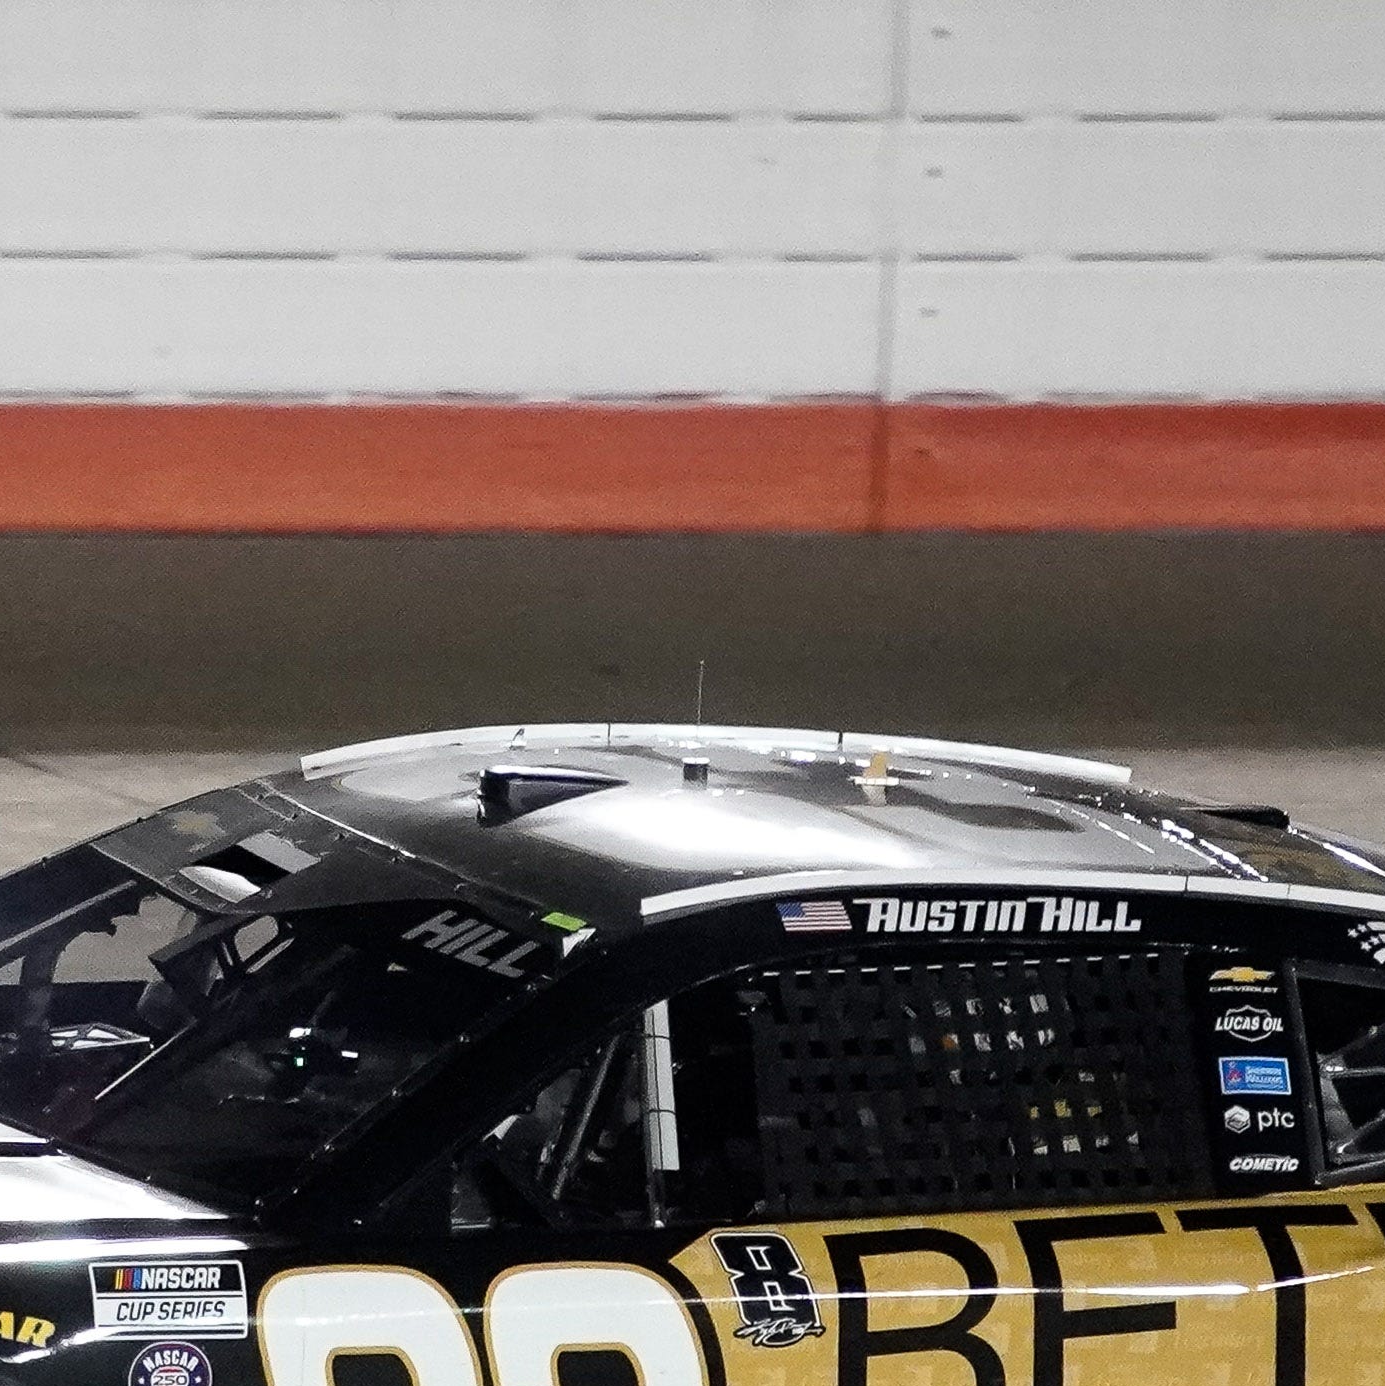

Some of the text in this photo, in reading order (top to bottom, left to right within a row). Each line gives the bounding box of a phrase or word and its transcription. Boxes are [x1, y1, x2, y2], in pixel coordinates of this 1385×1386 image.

[853, 896, 1142, 932] AUSTIN HILL
[402, 910, 540, 977] HILL
[1215, 1016, 1284, 1031] LUCAS OIL
[1257, 1107, 1295, 1131] ptc
[1229, 1156, 1299, 1171] COMETIC
[142, 1267, 221, 1289] NASCAR
[710, 1232, 822, 1328] 8
[117, 1300, 226, 1321] CUP SERIES
[142, 1350, 199, 1372] NASCAR
[153, 1375, 187, 1386] 250
